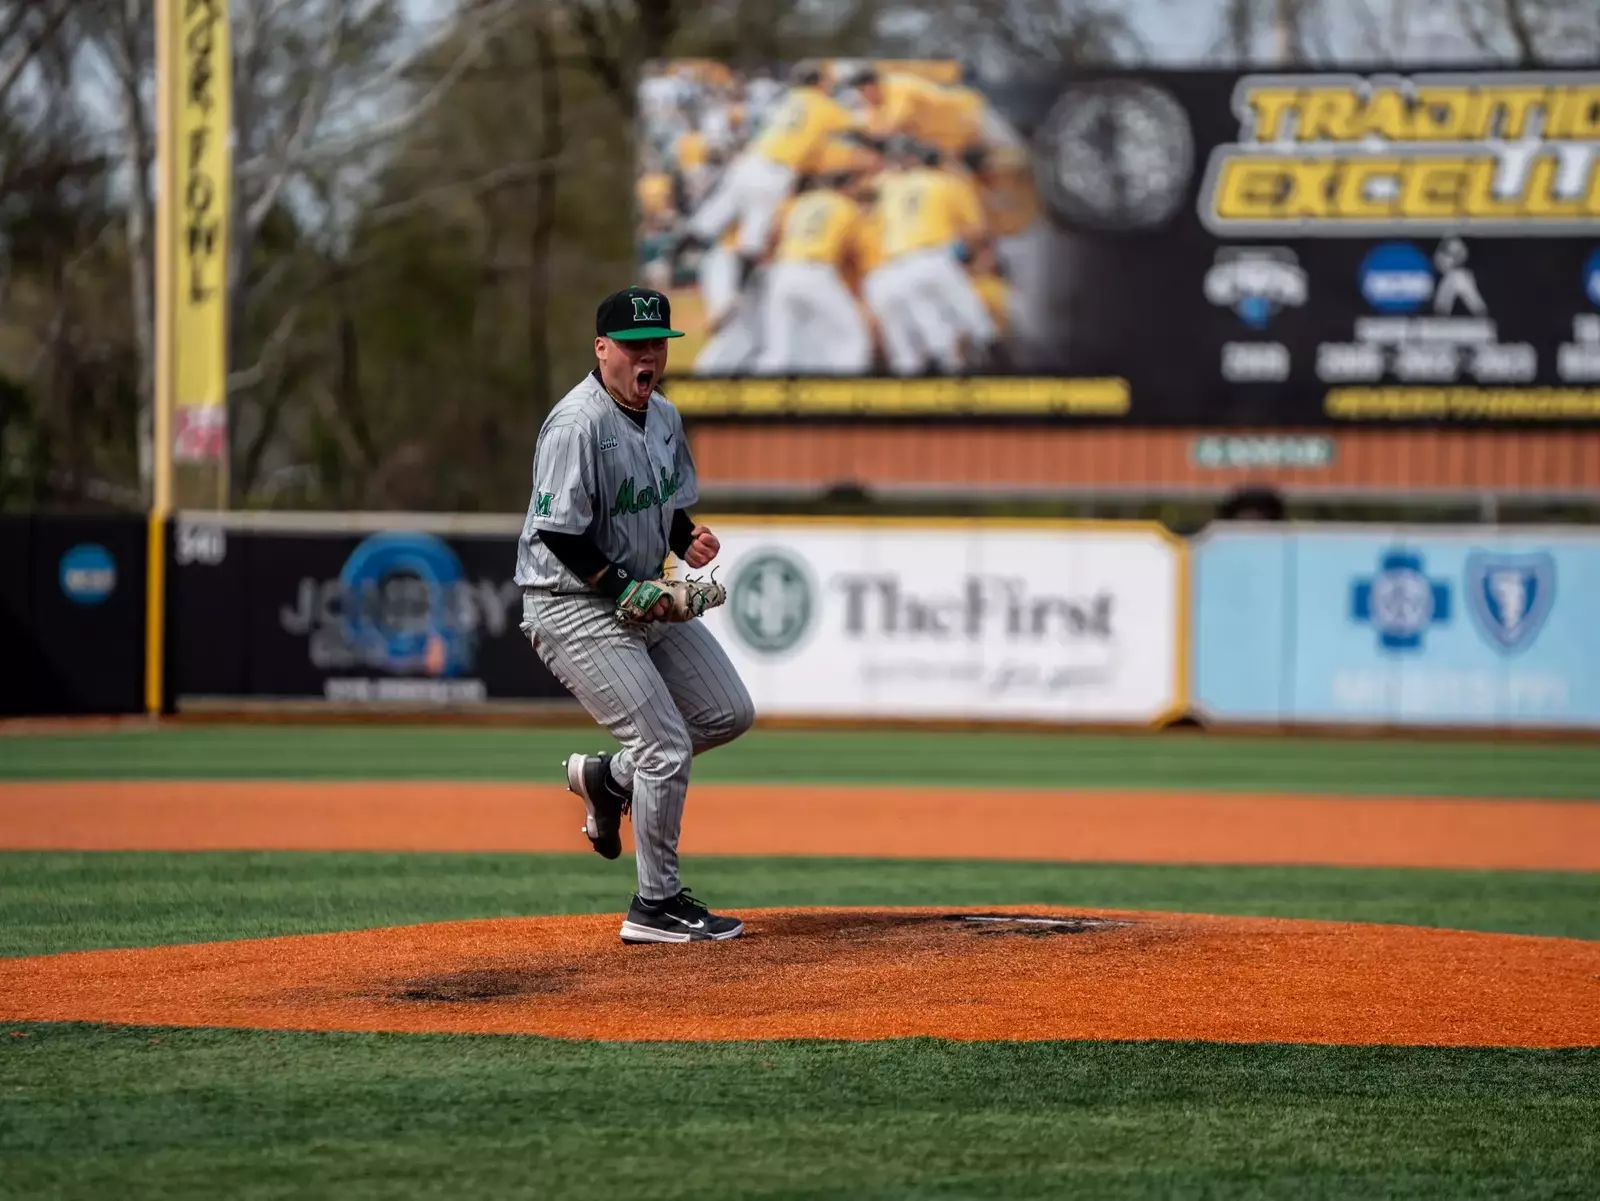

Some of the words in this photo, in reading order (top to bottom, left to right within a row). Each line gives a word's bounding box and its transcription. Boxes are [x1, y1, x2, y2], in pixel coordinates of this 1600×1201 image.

[1214, 155, 1600, 220] EXCELL
[632, 297, 662, 321] M
[600, 436, 619, 451] SBC
[534, 491, 555, 518] M
